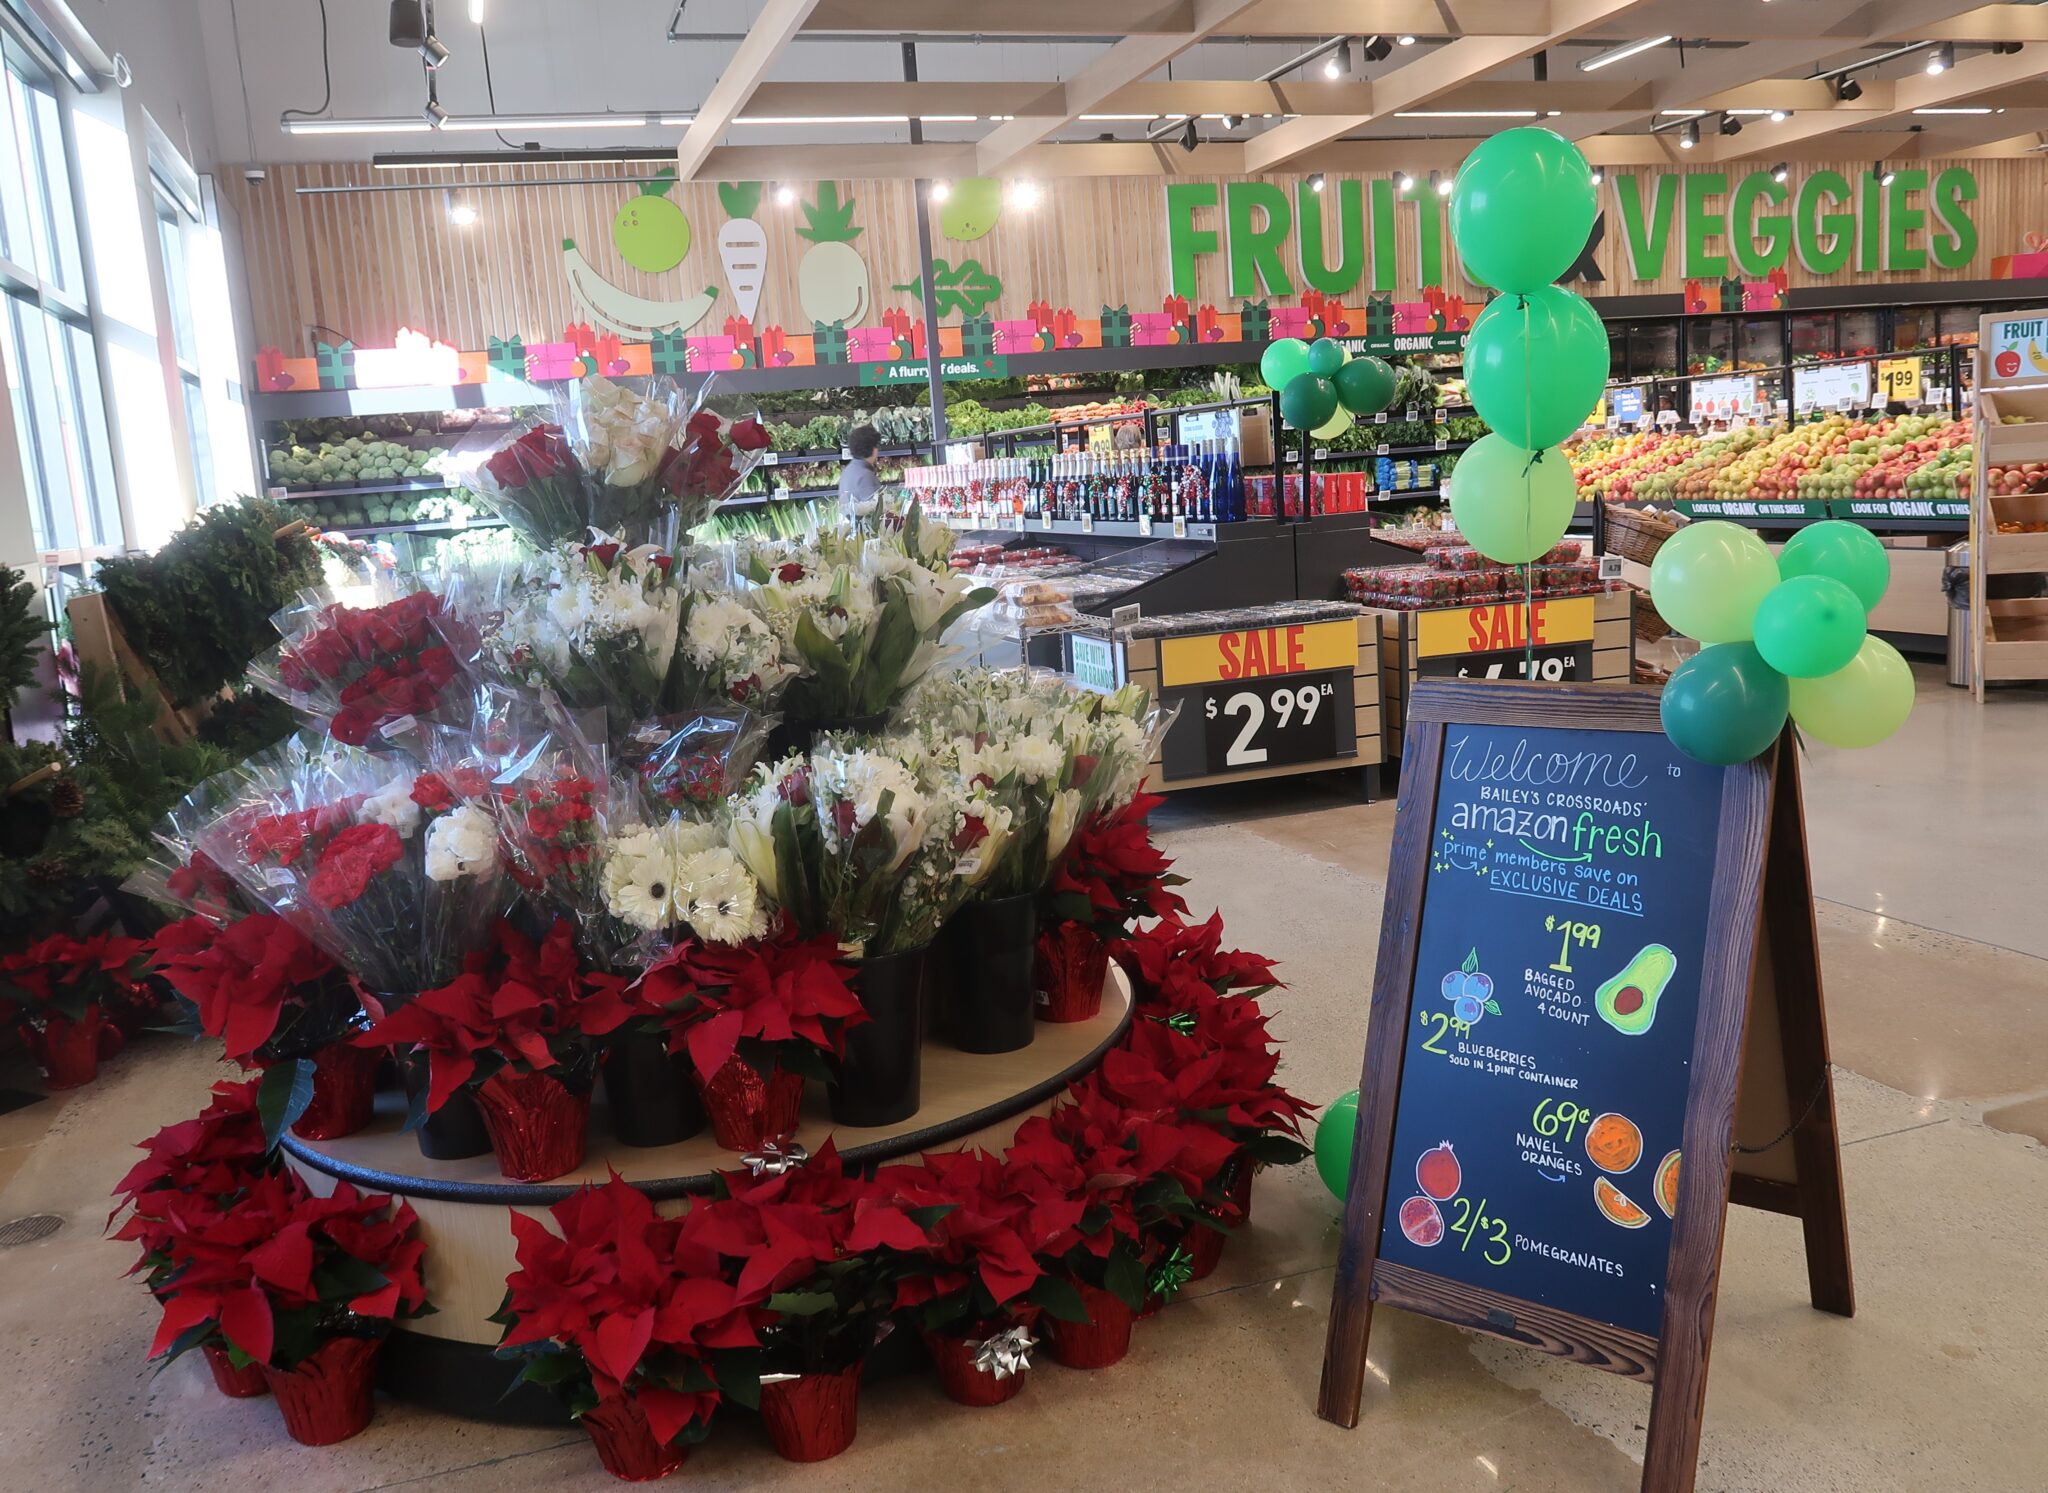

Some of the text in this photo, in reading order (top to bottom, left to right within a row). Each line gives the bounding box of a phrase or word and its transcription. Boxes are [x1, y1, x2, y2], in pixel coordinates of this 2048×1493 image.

[1164, 178, 1492, 300] FRUIT
[1611, 166, 1978, 281] VEGGIES
[2004, 320, 2043, 339] FRUIT
[1394, 336, 1433, 351] ORGANIC
[889, 366, 898, 378] A
[947, 361, 979, 374] deals.
[1692, 502, 1805, 515] LOOK FOR ORGANIC ON THIS SHELF
[1851, 503, 1872, 514] LOOK
[1873, 503, 1888, 513] FOR
[1890, 501, 1936, 516] ORGANIC
[1937, 503, 1949, 514] ON
[1468, 600, 1547, 652] SALE
[1075, 641, 1106, 667] SAVE WITH
[1218, 624, 1306, 681] SALE
[1563, 656, 1576, 668] EA
[1320, 683, 1334, 696] EA
[1449, 735, 1682, 789] Welcome to
[1480, 785, 1540, 804] BAILEY'S
[1451, 802, 1662, 858] amazon fresh
[1443, 841, 1639, 886] prime members save on
[1490, 868, 1644, 912] EXCLUSIVE DEALS
[1524, 968, 1575, 992] BAGGED
[1524, 983, 1582, 1008] AVOCADO
[1537, 1002, 1591, 1027] 4 COUNT
[1457, 1041, 1537, 1071] BLUEBERRIES
[1449, 1053, 1470, 1067] SOLD
[1473, 1059, 1484, 1070] IN
[1518, 1069, 1579, 1090] CONTAINER
[1516, 1132, 1563, 1155] NAVEL
[1521, 1150, 1583, 1176] ORANGES
[1515, 1233, 1625, 1278] POMEGRANATES
